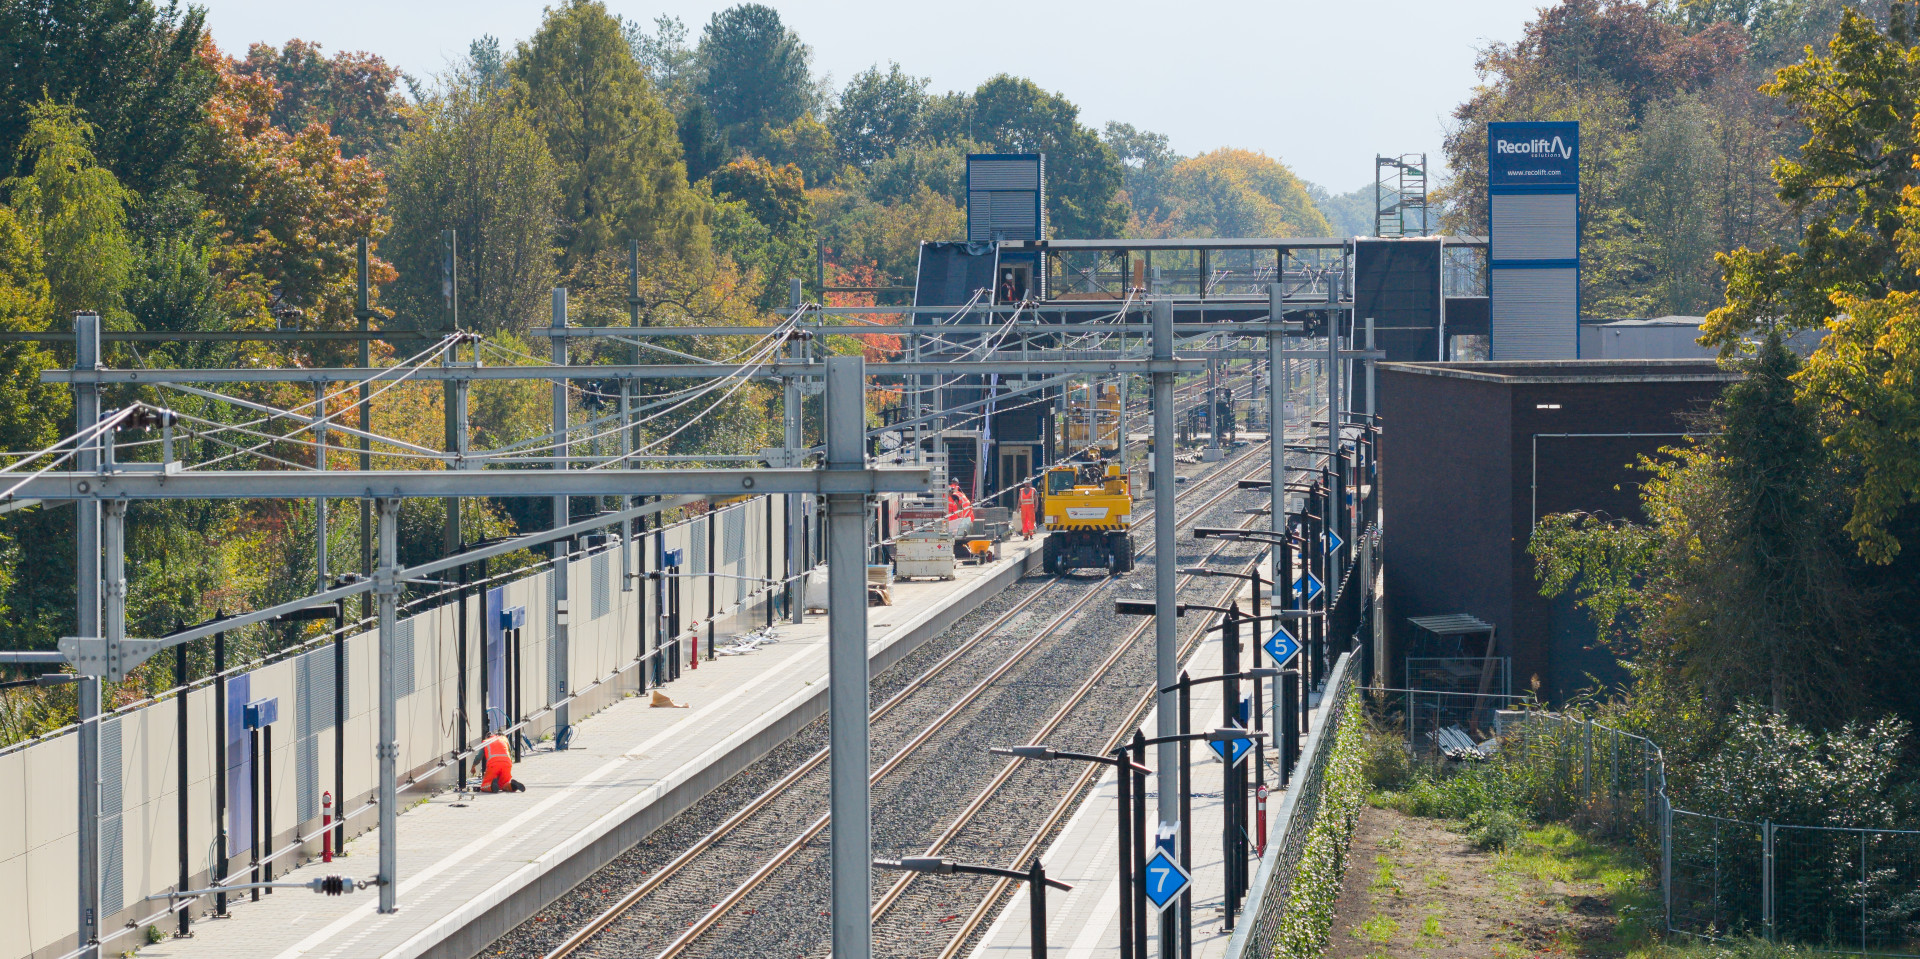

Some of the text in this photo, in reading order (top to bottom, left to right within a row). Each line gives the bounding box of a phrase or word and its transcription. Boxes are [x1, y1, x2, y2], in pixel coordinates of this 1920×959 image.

[1497, 139, 1550, 153] Recolift
[1274, 639, 1287, 655] 5
[1150, 868, 1170, 893] 7
